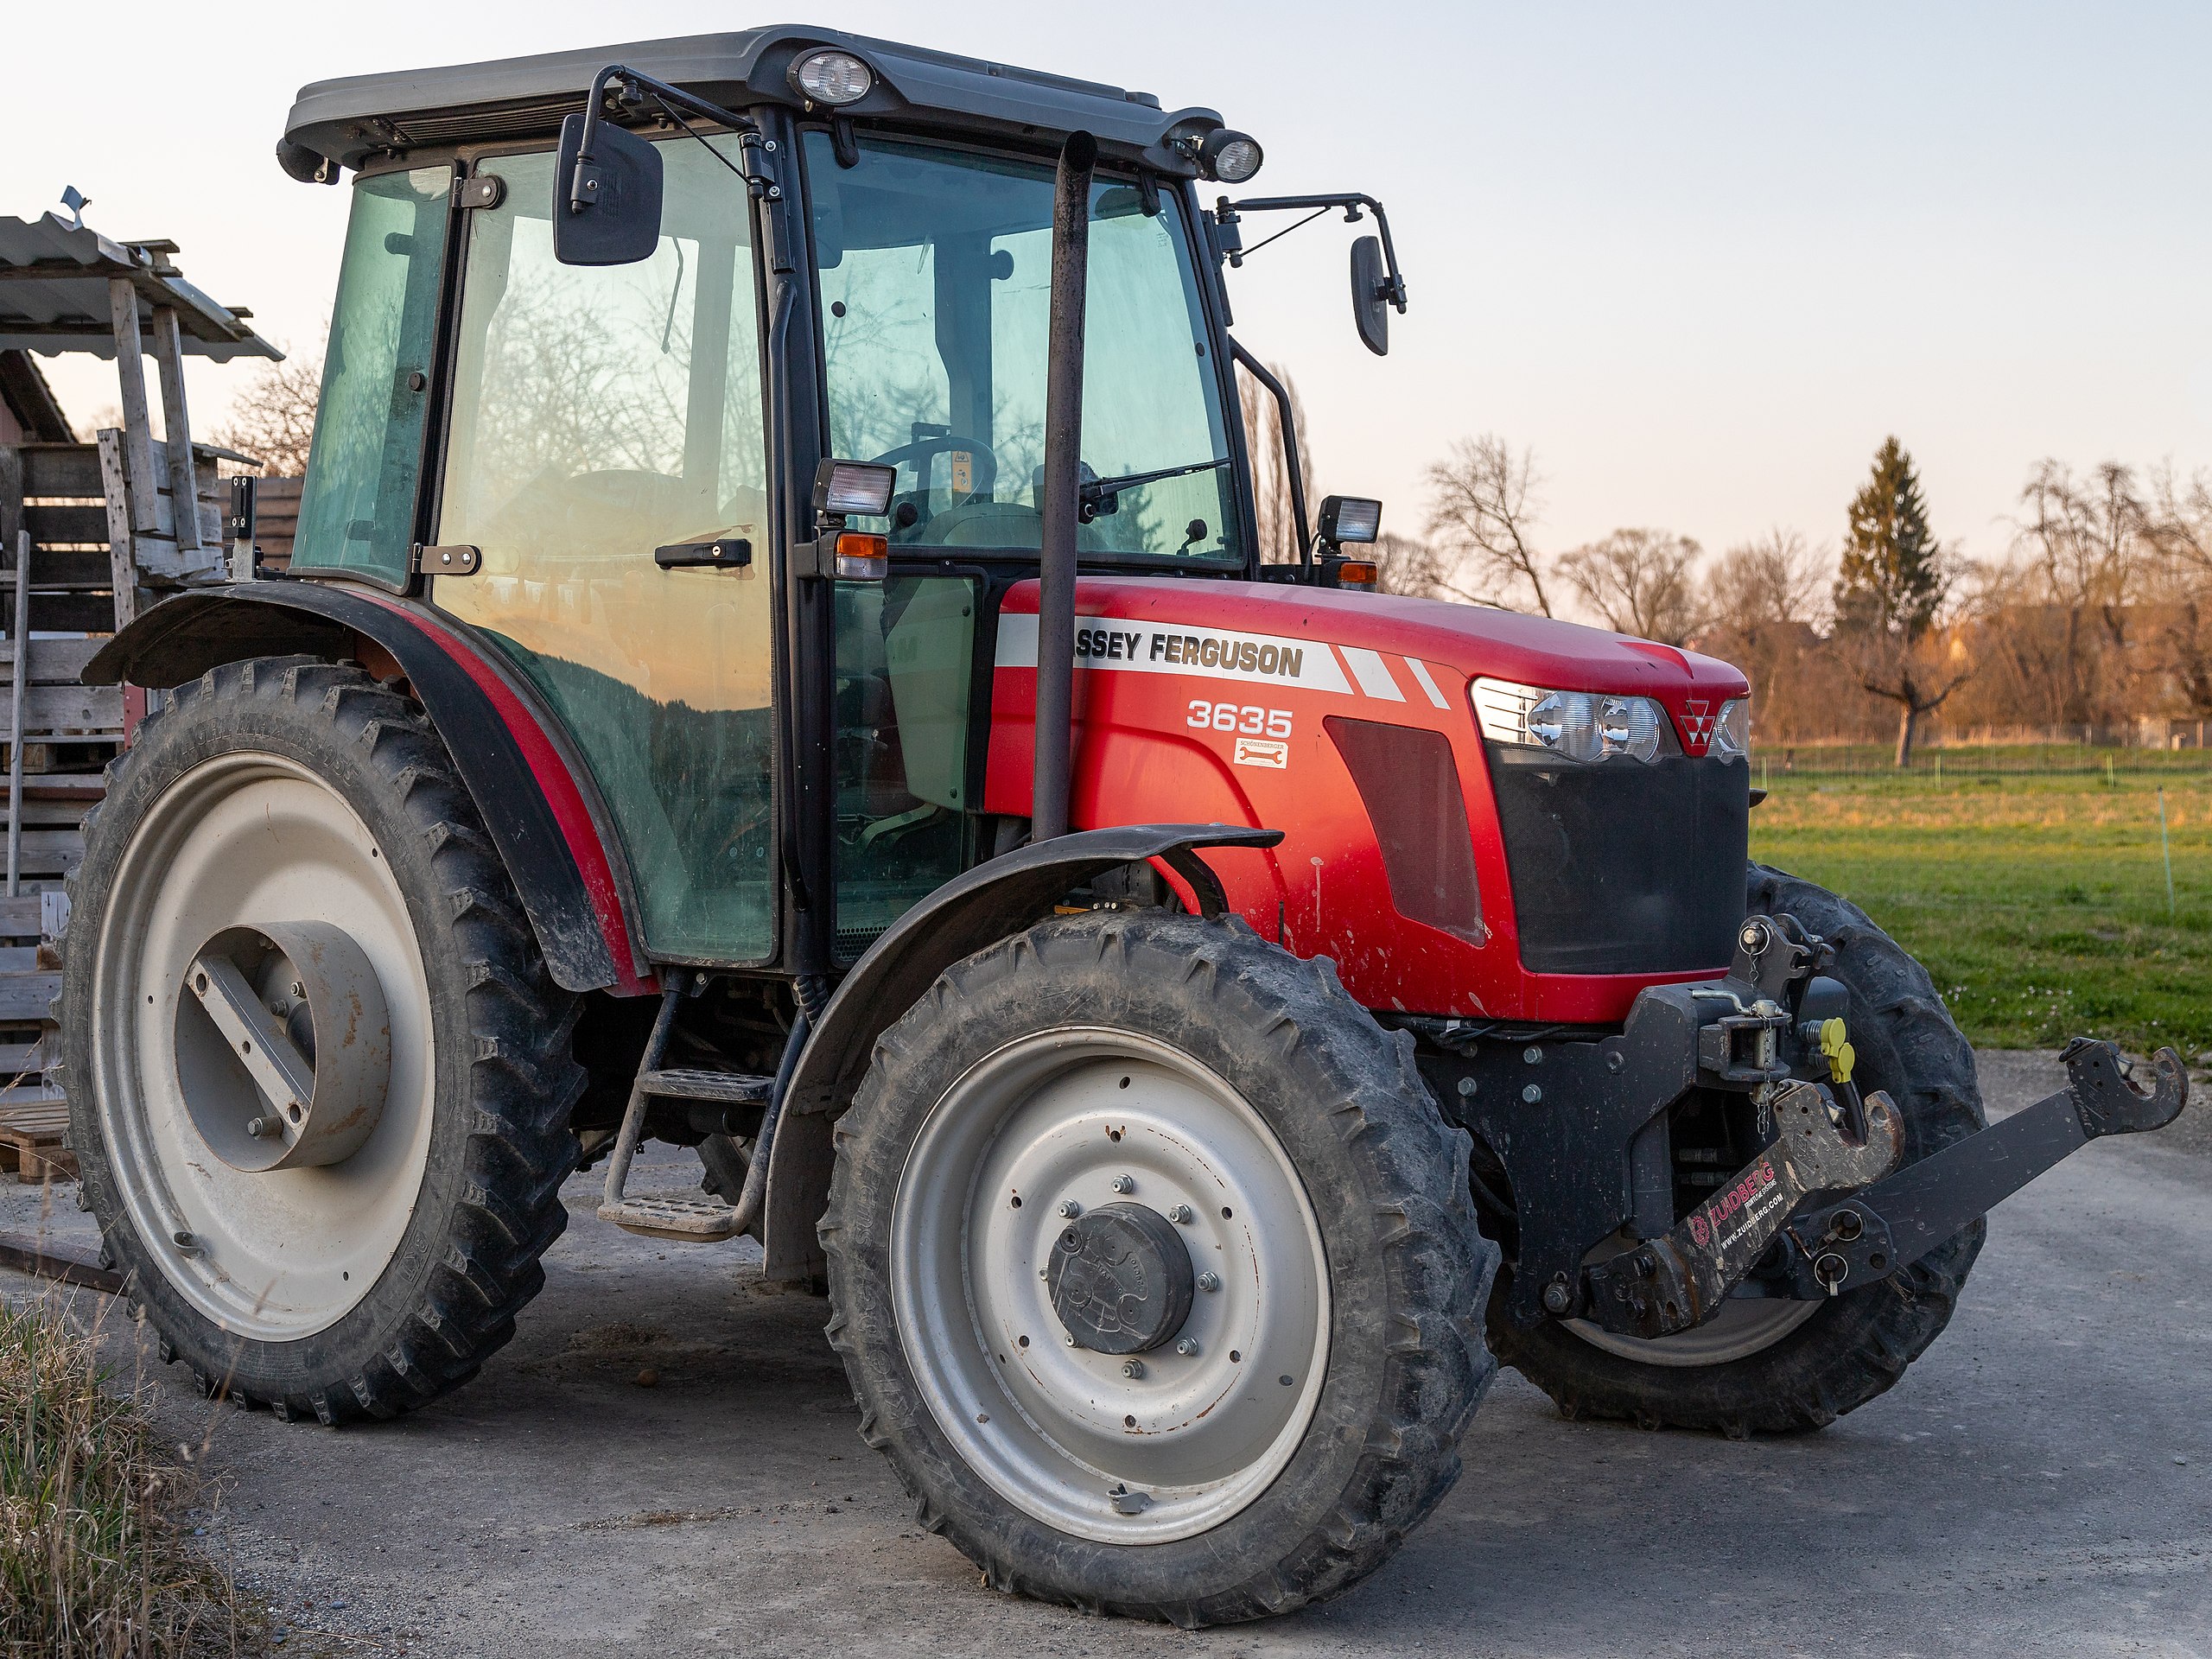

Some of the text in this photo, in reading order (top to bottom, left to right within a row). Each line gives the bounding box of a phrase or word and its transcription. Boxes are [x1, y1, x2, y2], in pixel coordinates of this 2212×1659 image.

[1071, 628, 1303, 678] SSEY FERGUSON
[1186, 699, 1294, 739] 3635
[1240, 740, 1285, 750] SCHÖNENBERGER
[1708, 1161, 1775, 1228] ZUIDBERG
[1720, 1192, 1784, 1250] WWW.ZUIDBERG.COM
[401, 1230, 429, 1282] BKT
